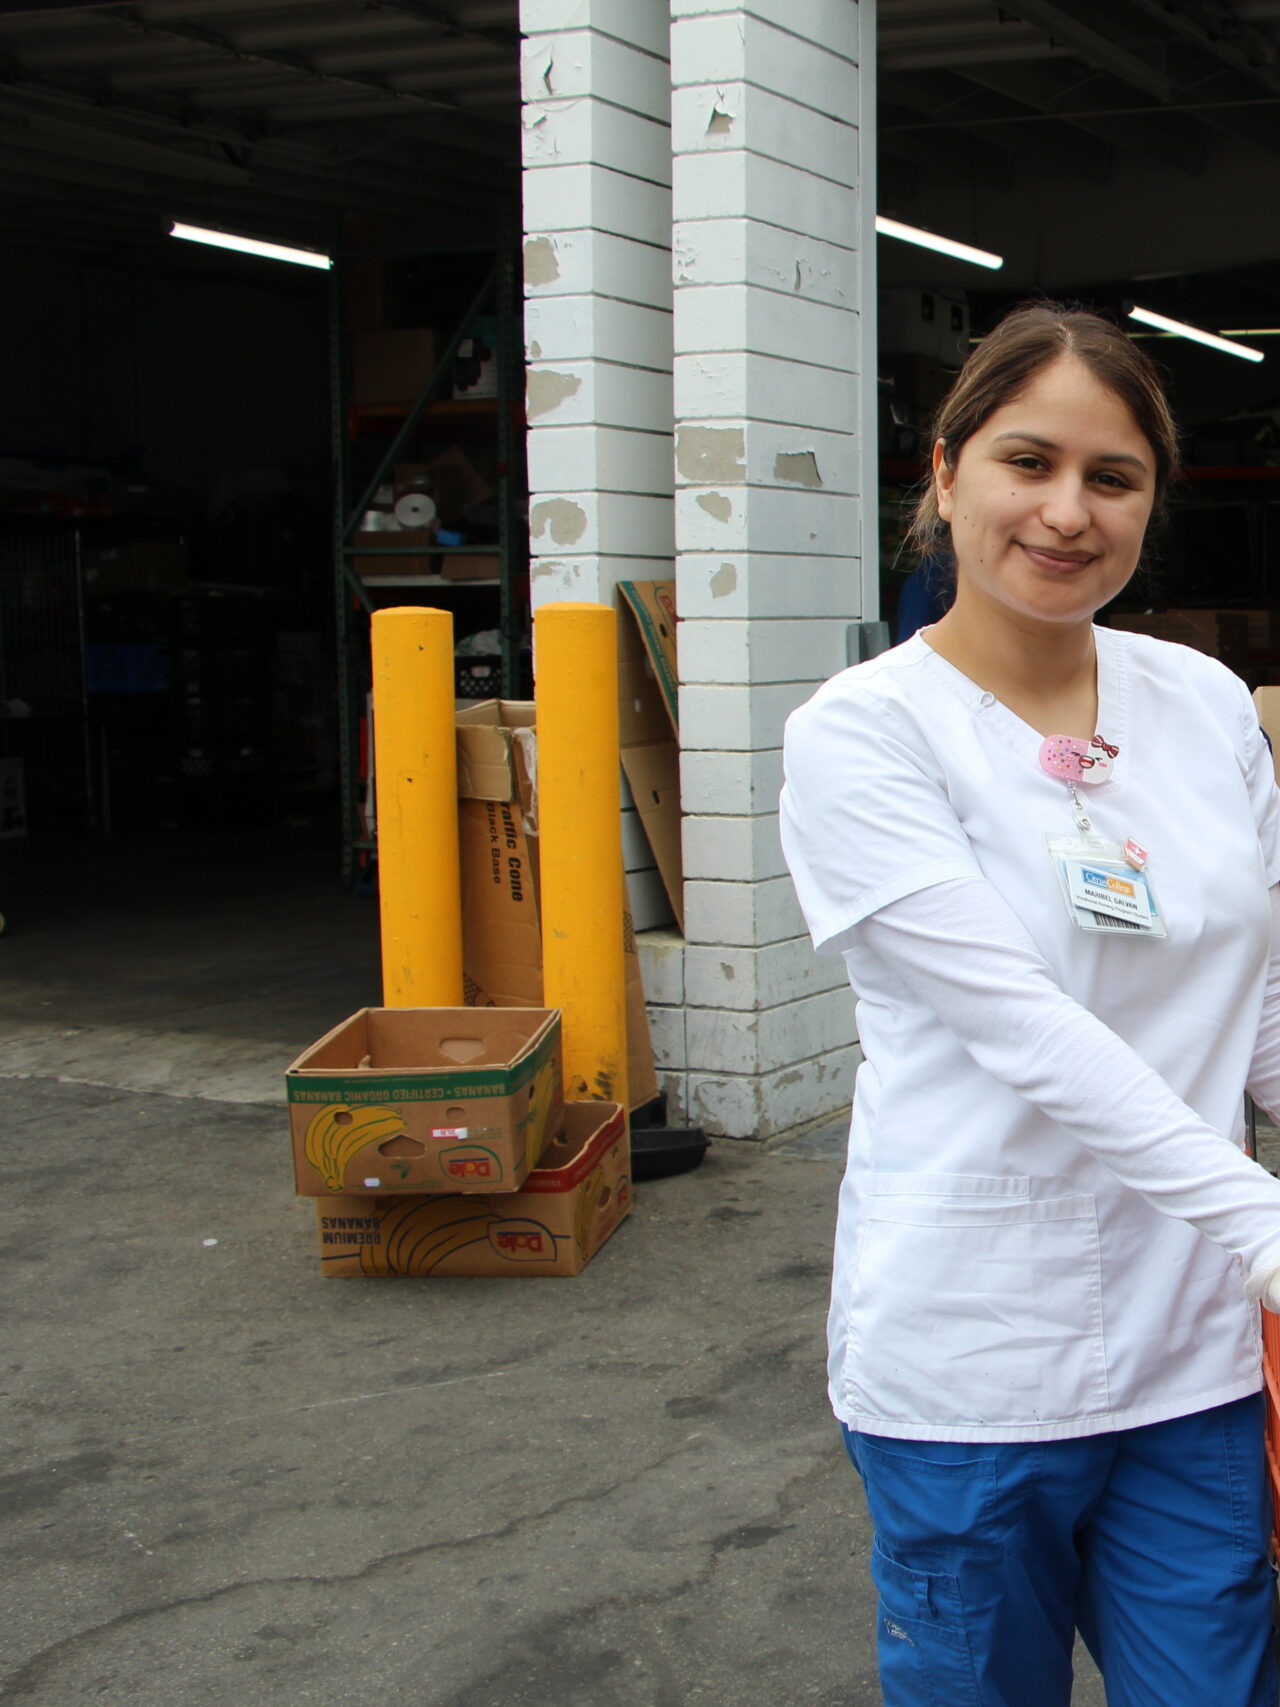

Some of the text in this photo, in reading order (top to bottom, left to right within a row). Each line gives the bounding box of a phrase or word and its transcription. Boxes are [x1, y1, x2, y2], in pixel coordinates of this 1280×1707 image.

[486, 802, 502, 884] Black Base
[500, 802, 523, 902] raffic Cone
[1084, 888, 1138, 910] MARIBEL GALVAN
[293, 1083, 505, 1102] BANANAS CERTIFIED ORGANIC BANANAS
[448, 1162, 490, 1177] Dole
[321, 1217, 381, 1230] BANANAS
[322, 1231, 381, 1245] PREMIUM
[497, 1235, 543, 1252] Dole
